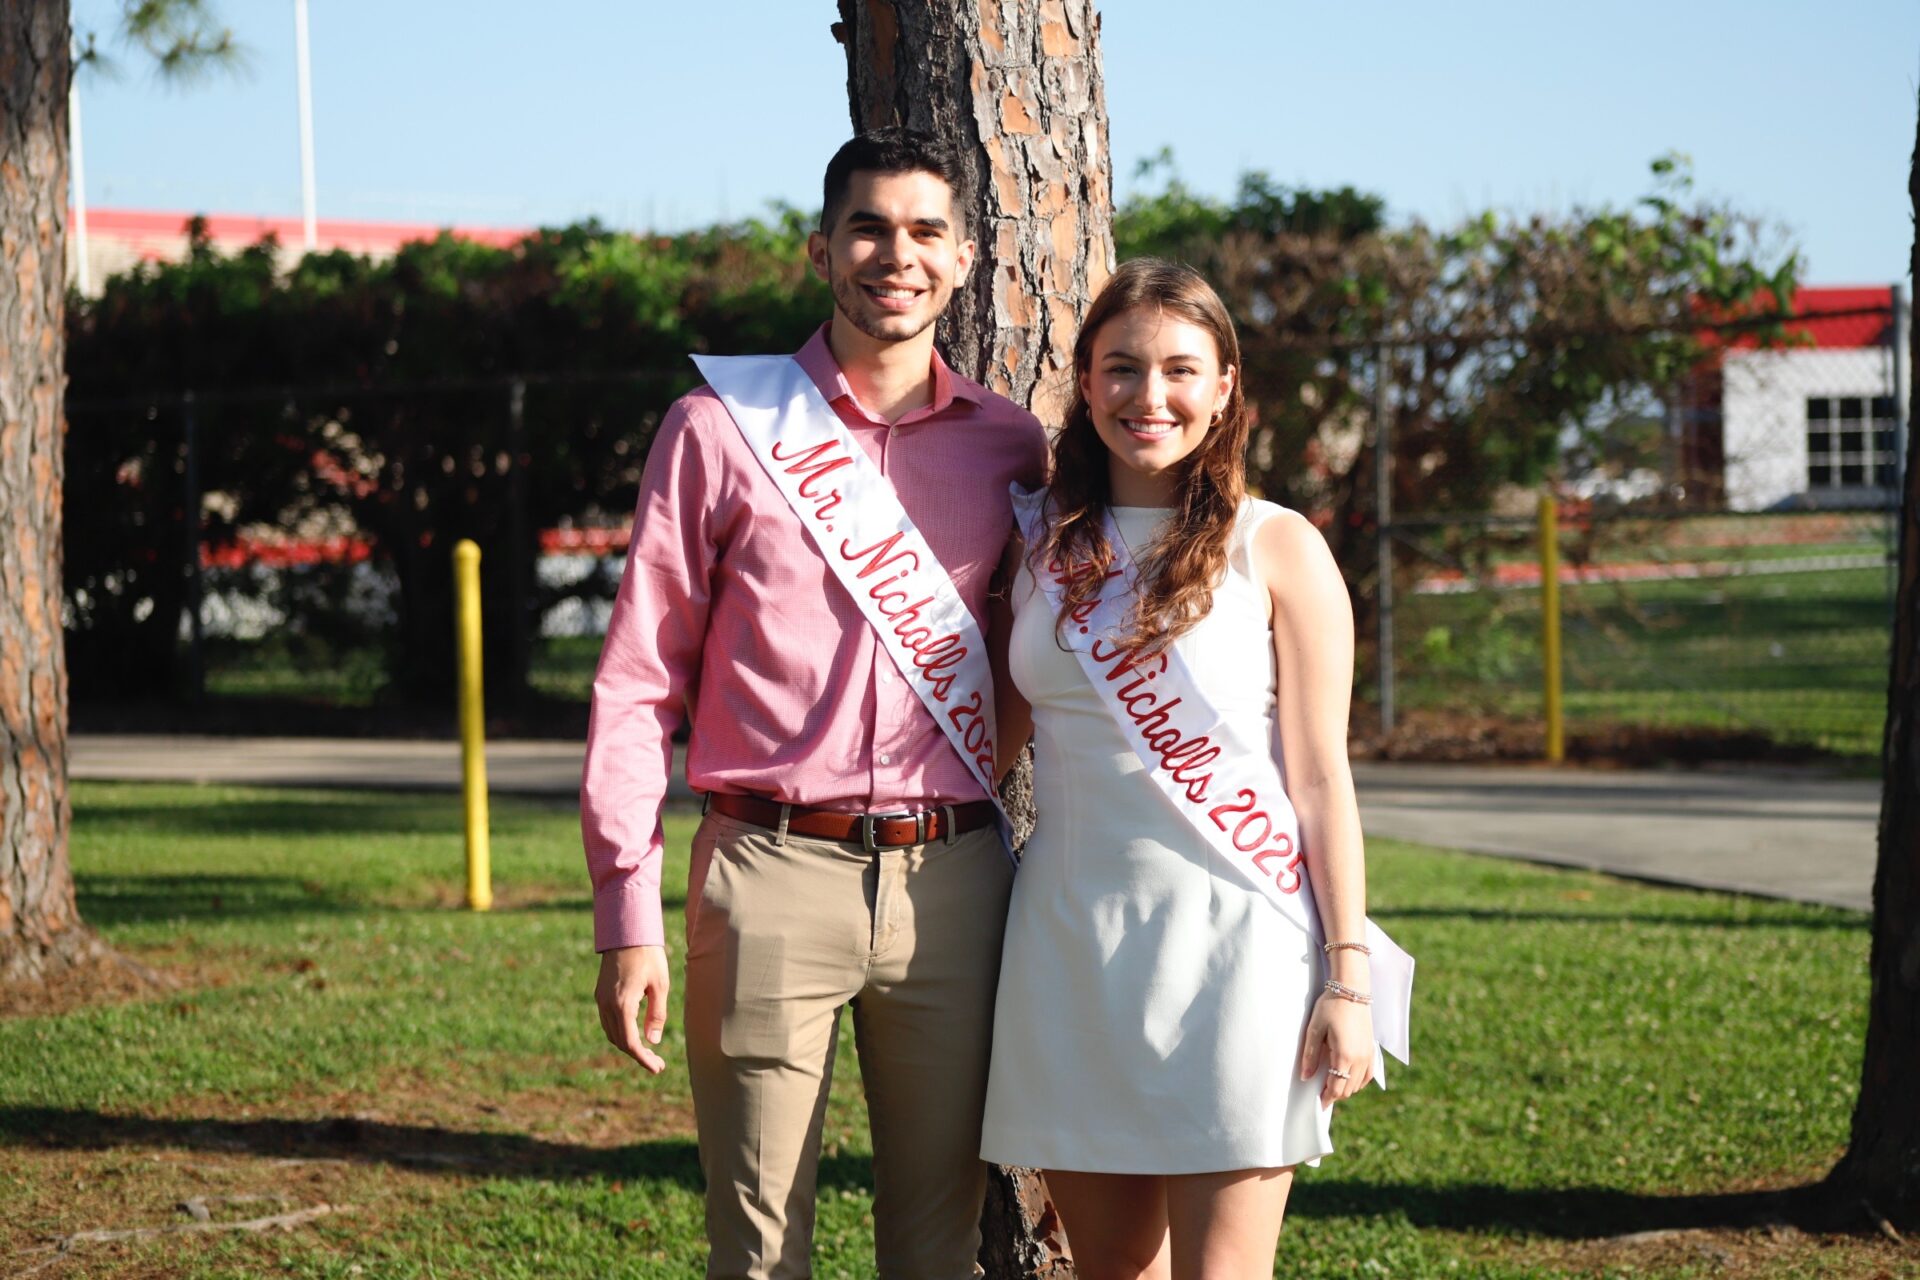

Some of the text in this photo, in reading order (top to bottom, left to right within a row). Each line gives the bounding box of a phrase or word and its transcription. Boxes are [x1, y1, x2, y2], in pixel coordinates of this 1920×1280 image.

[771, 438, 854, 533] Mr.
[839, 530, 968, 702] Nicholls
[1091, 638, 1221, 804] Nicholls
[1207, 788, 1306, 895] 2025
